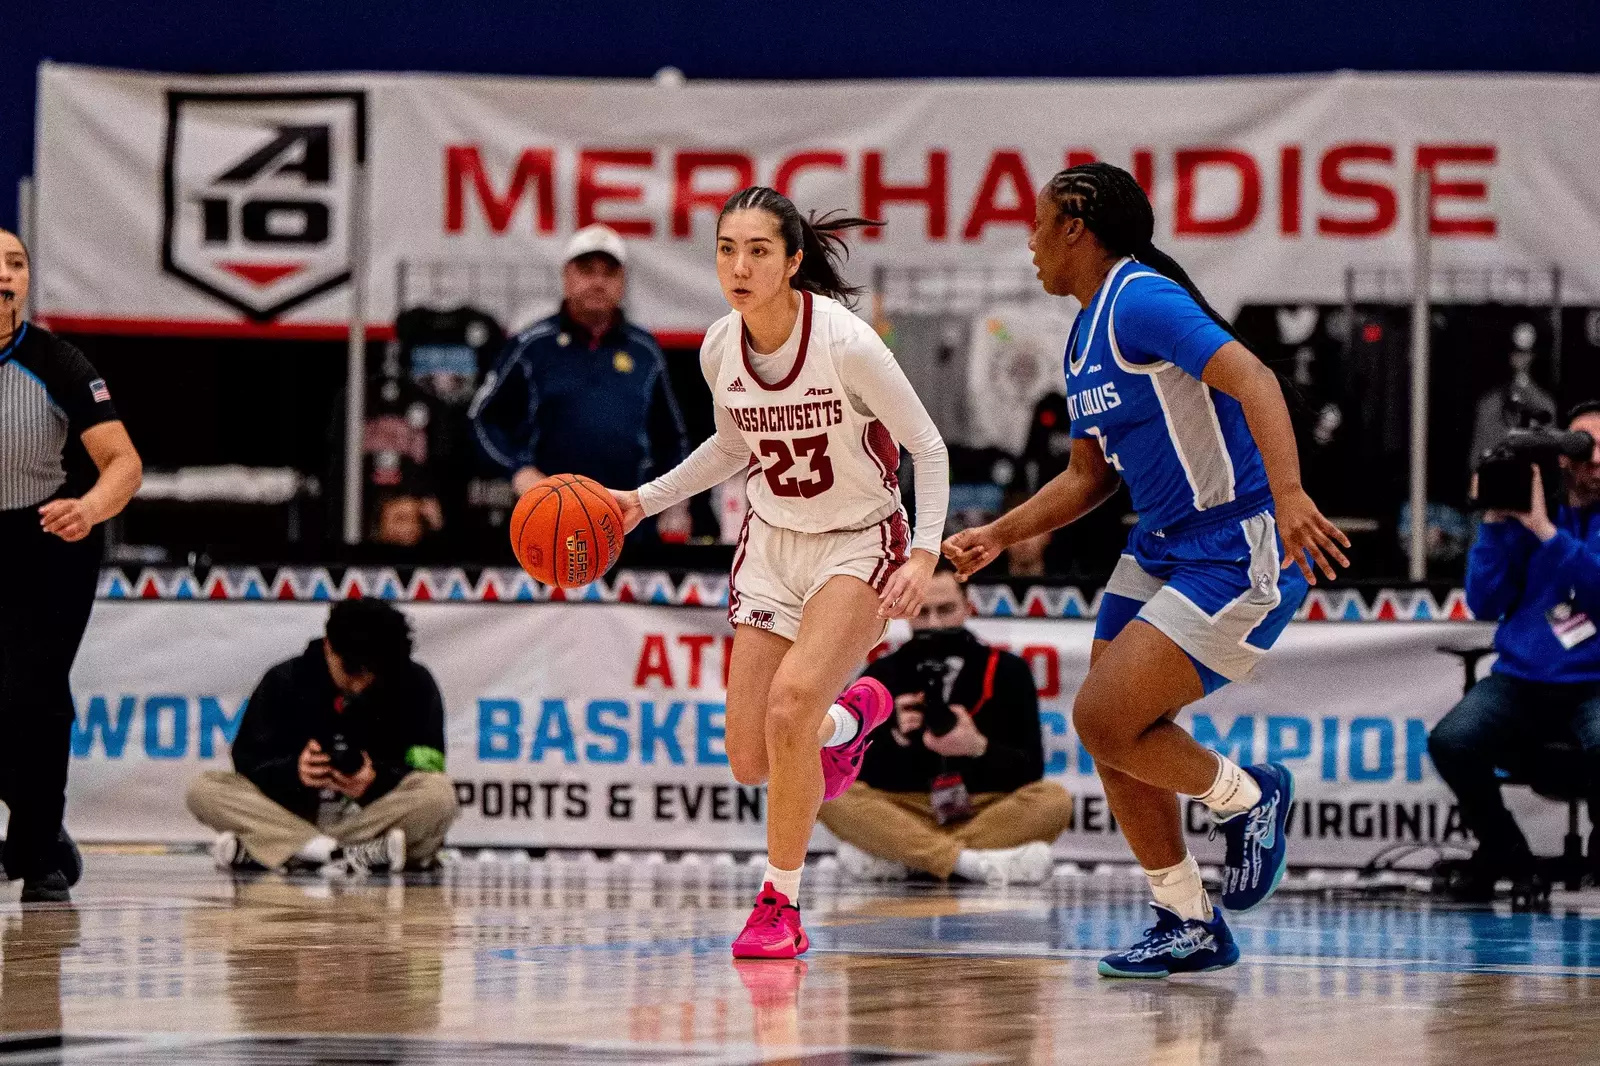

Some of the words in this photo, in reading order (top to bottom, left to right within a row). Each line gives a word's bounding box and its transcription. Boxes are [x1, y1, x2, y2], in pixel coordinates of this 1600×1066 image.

[444, 141, 1498, 240] MERCHADISE
[203, 199, 331, 243] 10
[759, 432, 834, 499] 23
[608, 783, 632, 819] &
[655, 784, 767, 821] EVEN
